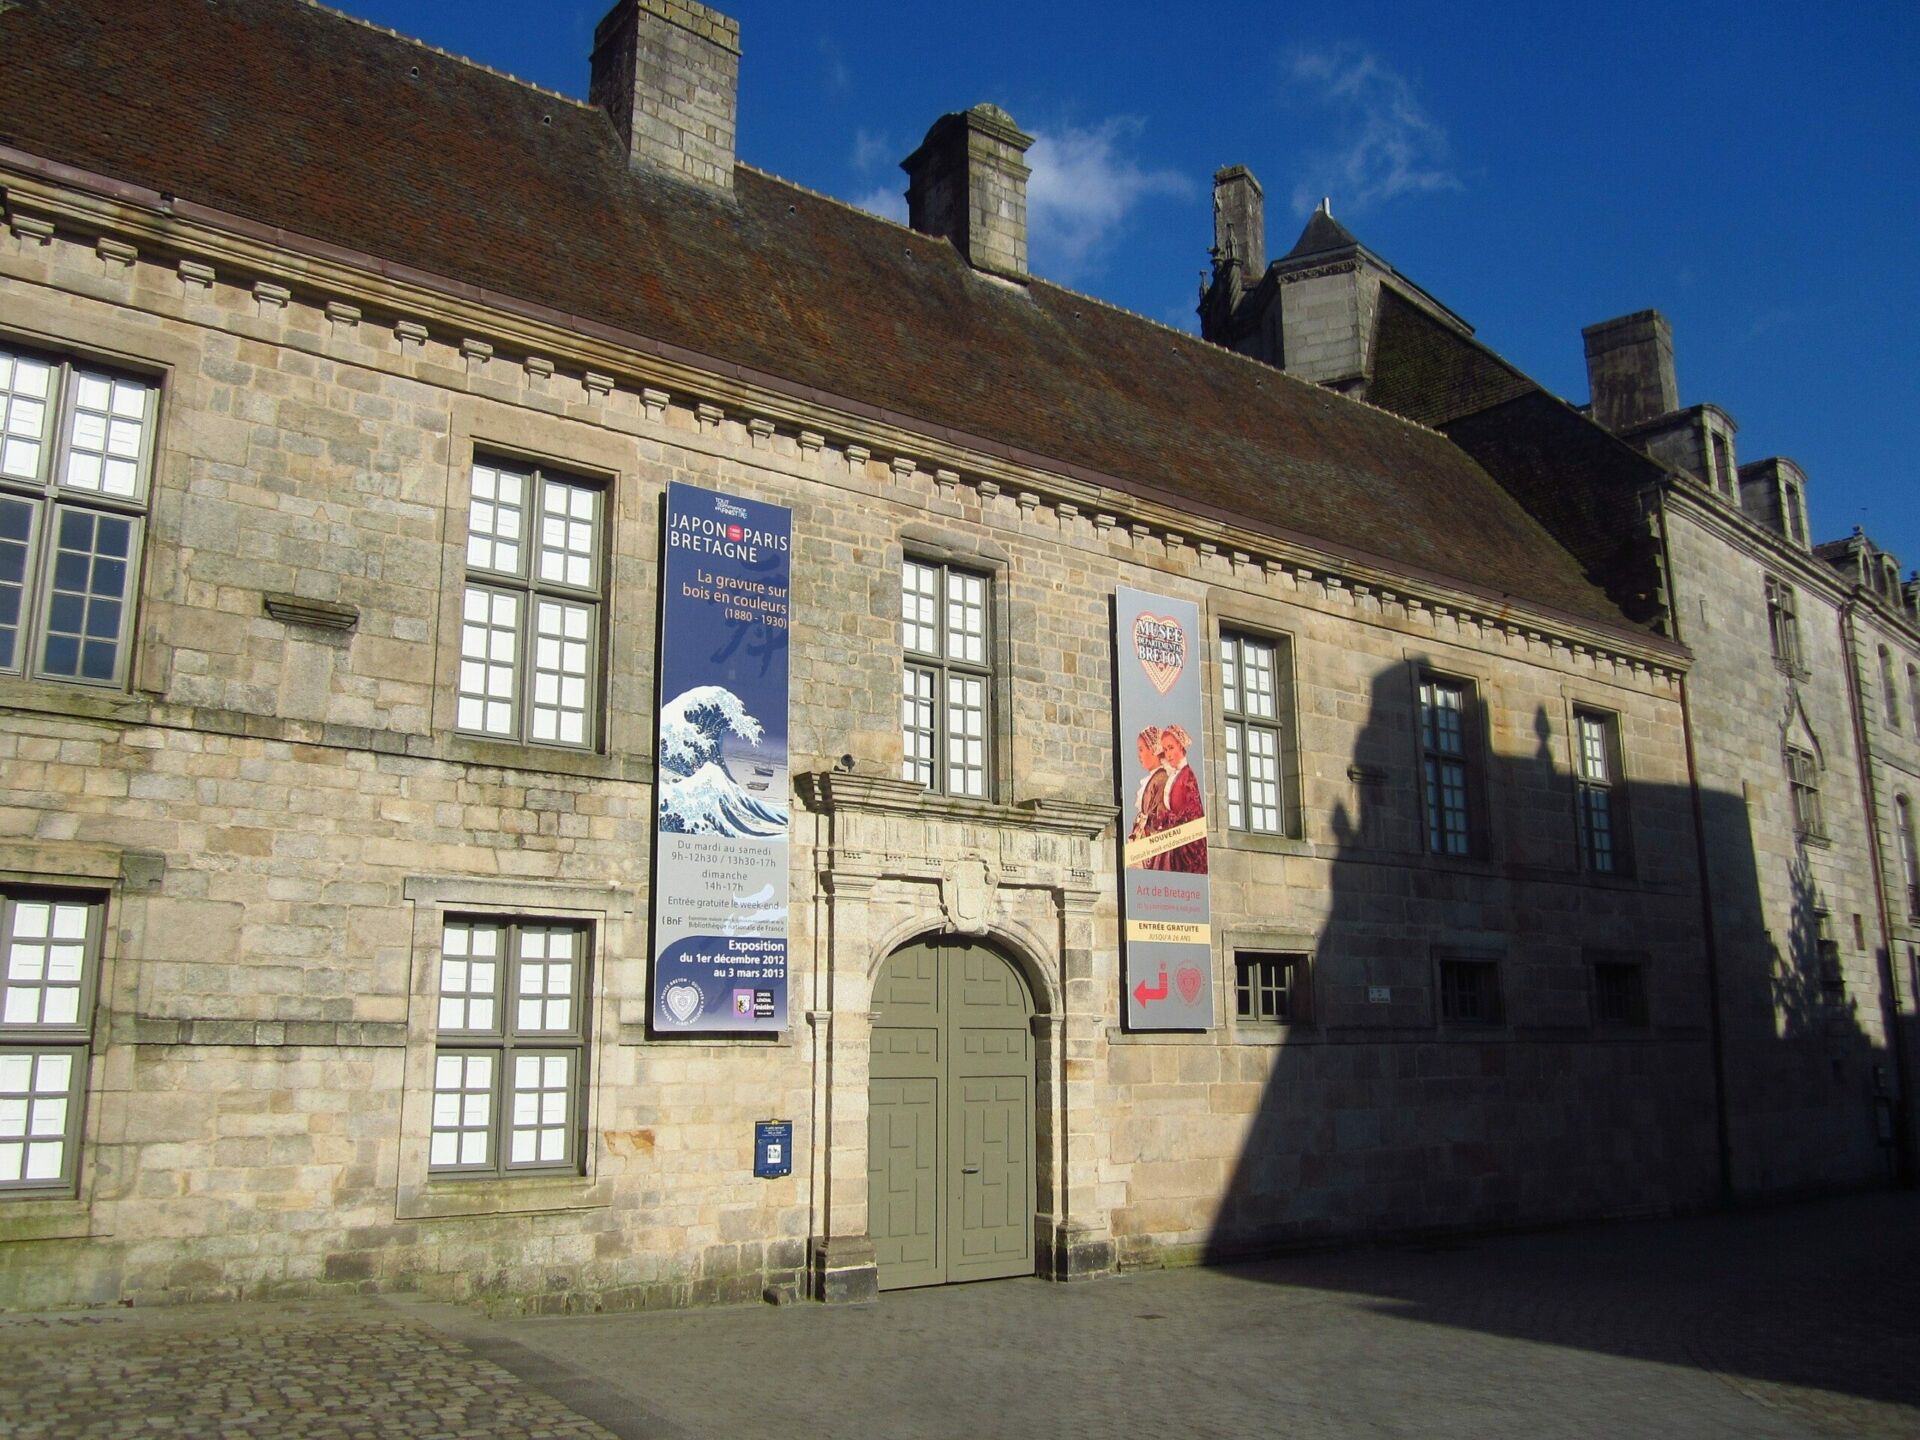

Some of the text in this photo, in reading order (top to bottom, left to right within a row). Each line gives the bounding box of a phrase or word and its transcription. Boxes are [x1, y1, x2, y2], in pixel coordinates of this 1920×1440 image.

[670, 512, 726, 538] JAPON
[744, 528, 788, 551] PARIS
[670, 531, 758, 563] BRETAGNE
[698, 569, 787, 598] La gravure sur
[682, 582, 786, 614] bois en couleurs
[724, 608, 752, 622] (1880
[762, 614, 787, 630] 1930)
[1138, 646, 1183, 668] BRETON
[1149, 829, 1182, 844] NOUVEAU
[678, 840, 771, 856] Du mardi au samedi
[702, 870, 748, 880] dimanche
[1136, 886, 1200, 901] Art de Bretagne
[668, 896, 779, 910] Entrée gratuite le week-end
[1138, 922, 1199, 932] ENTRÉE GRATUITE
[728, 940, 784, 953] Exposition
[680, 953, 784, 965] du 1er décembre 2012
[714, 968, 784, 978] au 3 mars 2013
